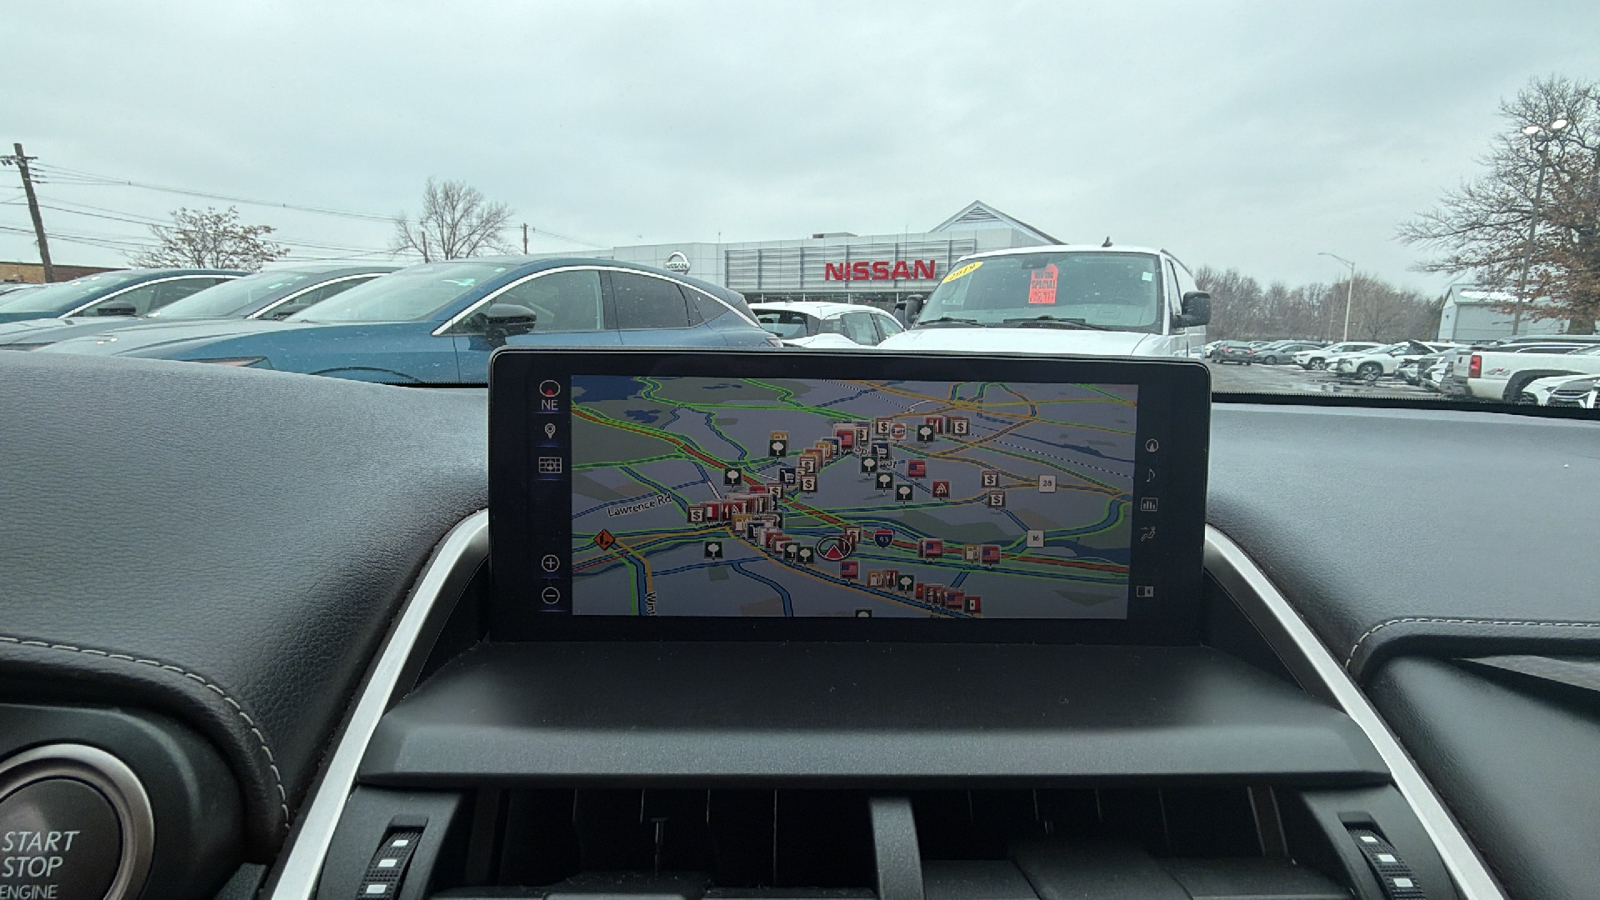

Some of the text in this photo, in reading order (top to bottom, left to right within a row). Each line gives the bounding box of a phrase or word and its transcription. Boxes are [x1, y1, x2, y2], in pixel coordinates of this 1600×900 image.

[825, 260, 935, 280] NISSAN
[541, 399, 559, 411] NE
[607, 493, 672, 517] Lawrence Rd
[2, 830, 80, 852] START
[2, 856, 63, 877] STOP
[0, 884, 59, 899] ENGINE
